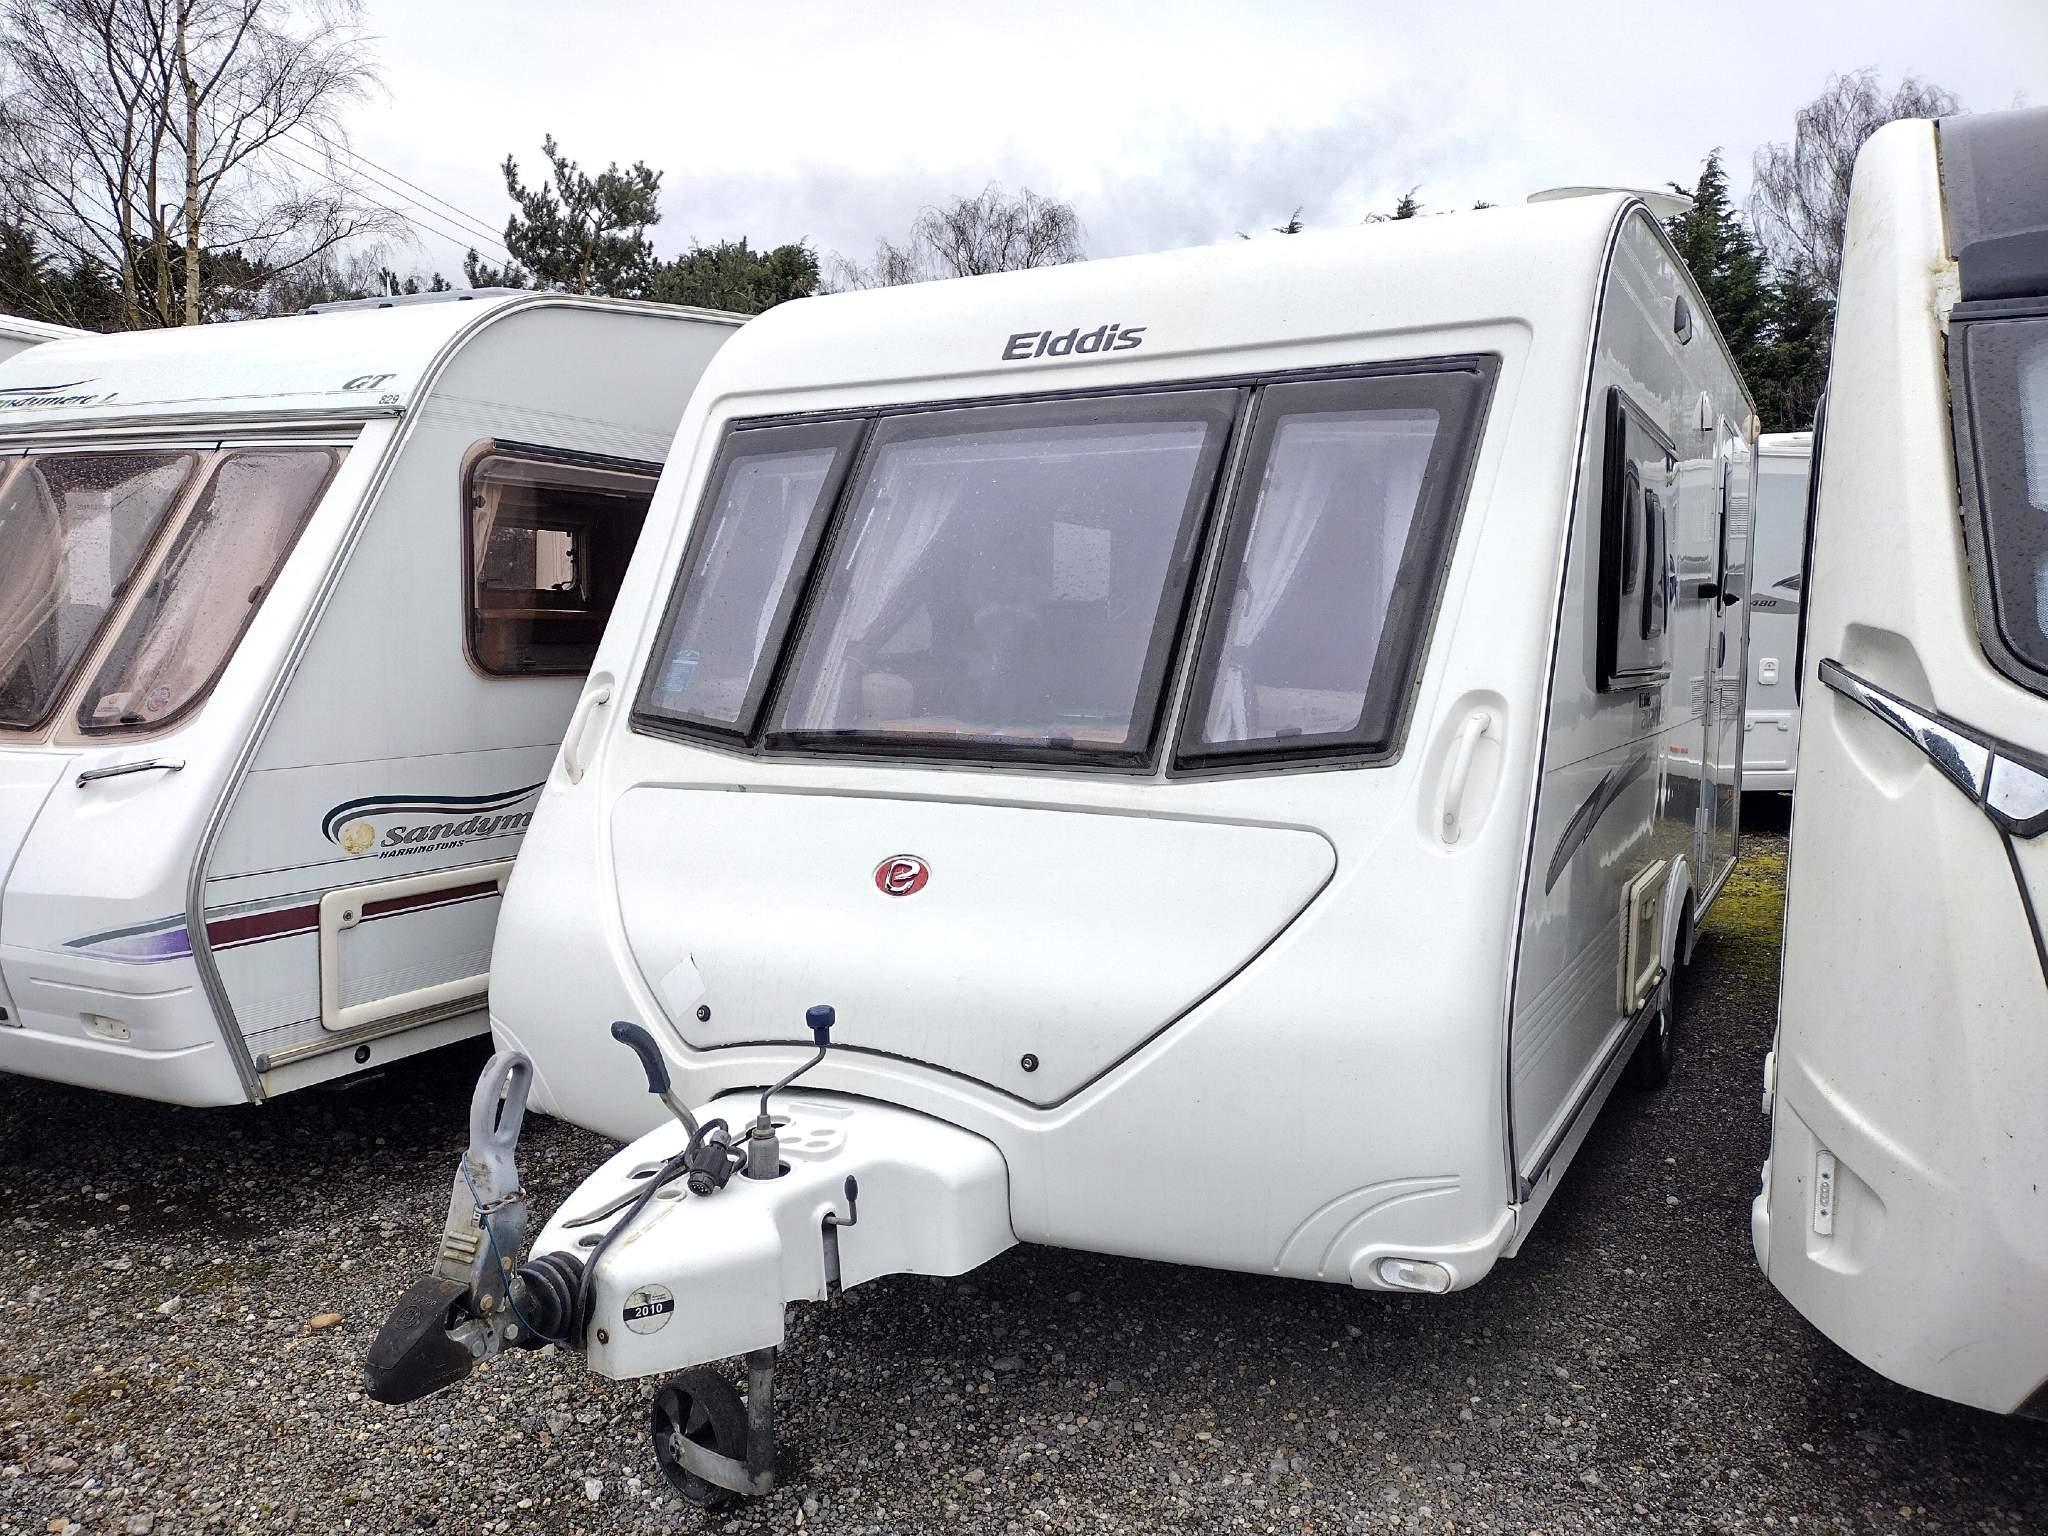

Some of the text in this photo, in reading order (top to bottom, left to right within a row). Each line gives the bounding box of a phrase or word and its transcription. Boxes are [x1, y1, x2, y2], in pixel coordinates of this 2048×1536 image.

[1001, 323, 1148, 361] Elddis
[378, 394, 400, 405] 829
[635, 1303, 663, 1317] 2010
